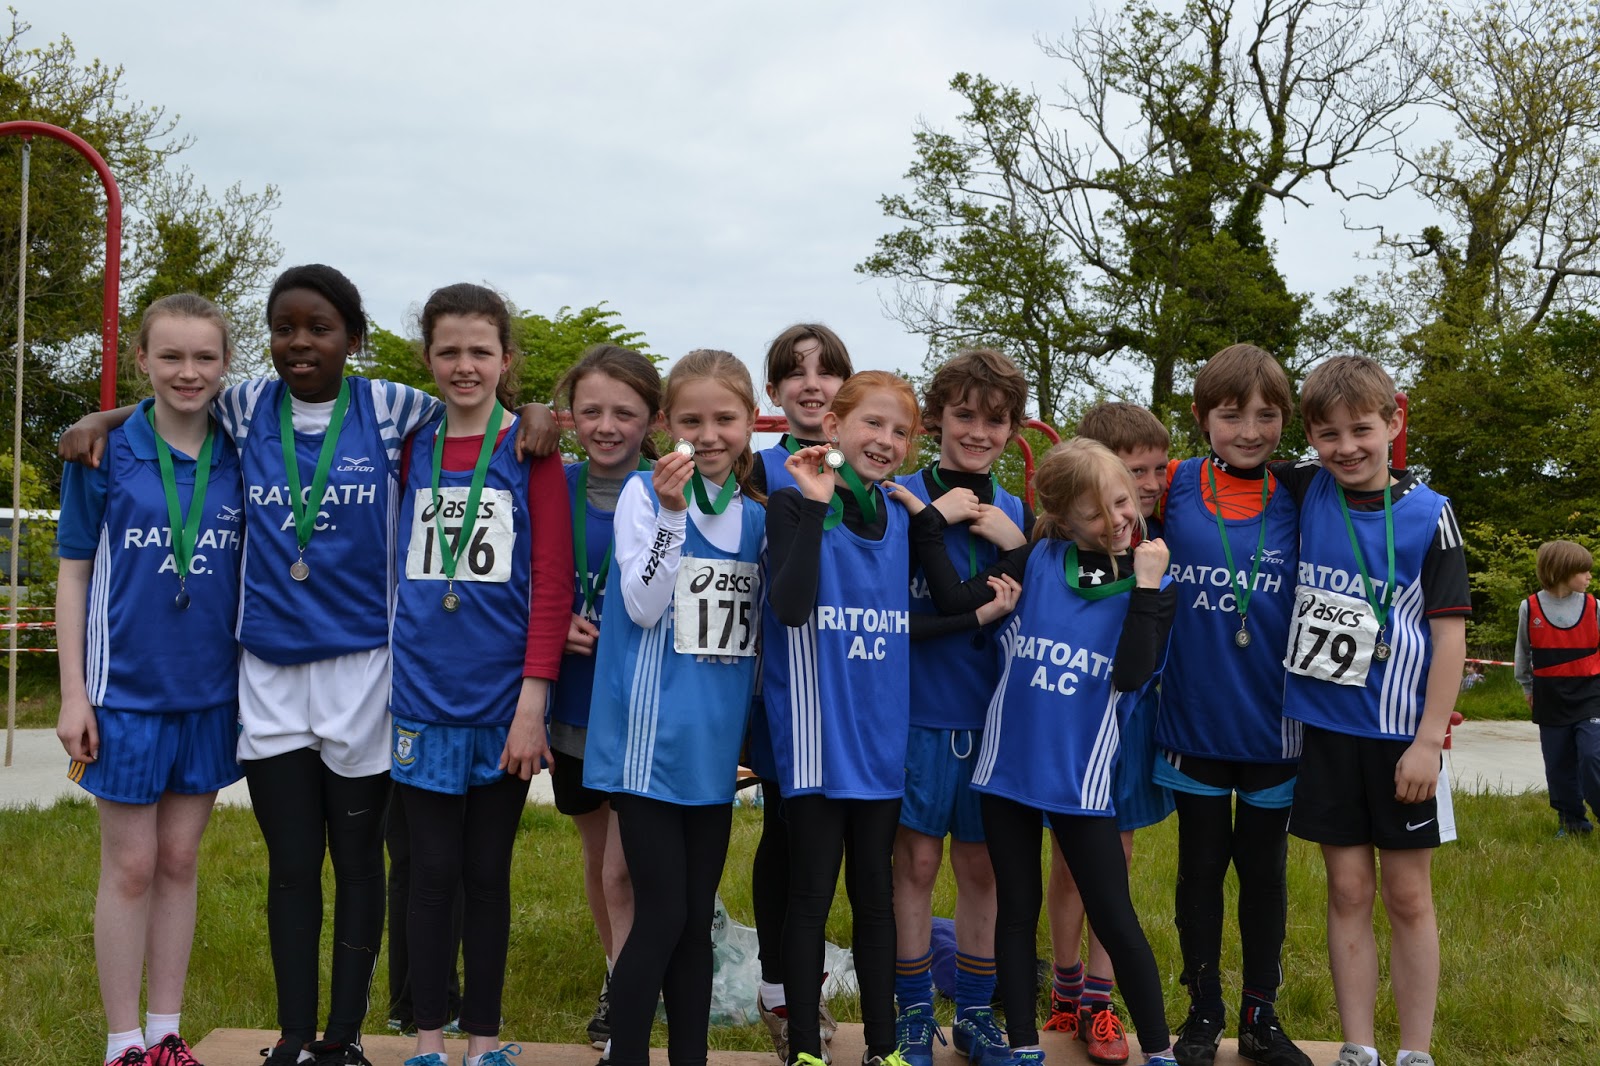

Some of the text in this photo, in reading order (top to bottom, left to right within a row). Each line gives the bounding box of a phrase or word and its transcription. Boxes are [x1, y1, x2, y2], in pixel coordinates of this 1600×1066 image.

[281, 511, 337, 531] AC.
[124, 527, 241, 550] RATATH
[423, 527, 495, 575] 176
[158, 554, 213, 575] AC.
[1250, 555, 1284, 565] LSTON
[1169, 564, 1282, 593] RATOATH
[1297, 561, 1404, 607] RATOATH
[698, 599, 751, 650] 175
[818, 606, 909, 634] RATOATH
[847, 636, 886, 661] A.C
[1289, 623, 1356, 679] 179
[1030, 665, 1078, 696] A.C
